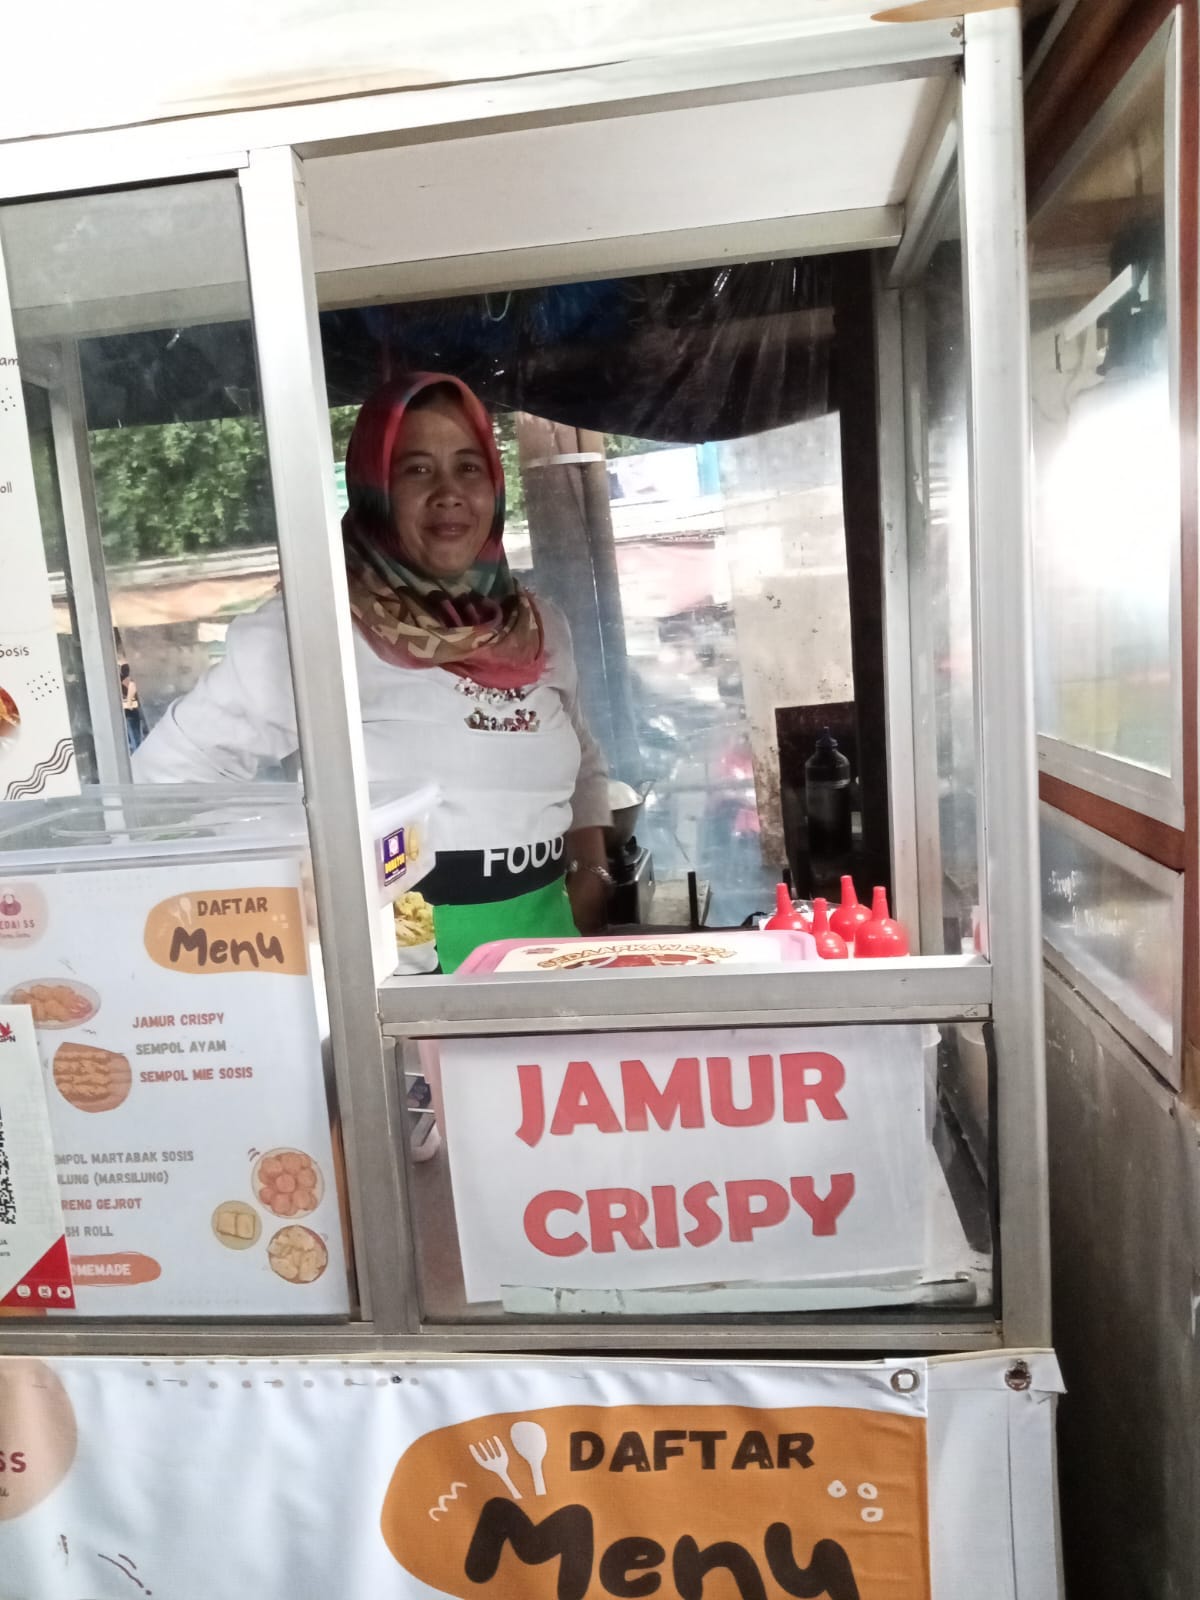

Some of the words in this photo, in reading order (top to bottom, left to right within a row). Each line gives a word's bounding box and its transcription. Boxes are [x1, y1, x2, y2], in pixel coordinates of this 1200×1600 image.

[197, 897, 268, 916] DAFTAR
[169, 926, 284, 968] Menu
[132, 1015, 175, 1028] JAMUR
[180, 1012, 225, 1026] CRISPY
[135, 1042, 185, 1055] SEMPOL
[189, 1039, 227, 1053] AYAM
[140, 1069, 189, 1083] SEMPOL
[192, 1068, 214, 1080] MIE
[219, 1066, 254, 1079] SOSIS
[516, 1051, 848, 1147] JAMUR
[91, 1151, 158, 1164] MARTABAK
[161, 1150, 195, 1162] SOSIS
[93, 1170, 170, 1186] (MARSILUNG)
[96, 1198, 143, 1210] GEJROT
[523, 1173, 856, 1257] CRISPY
[84, 1226, 115, 1237] ROLL
[569, 1430, 815, 1473] DAFTAR
[464, 1496, 861, 1600] Menu
